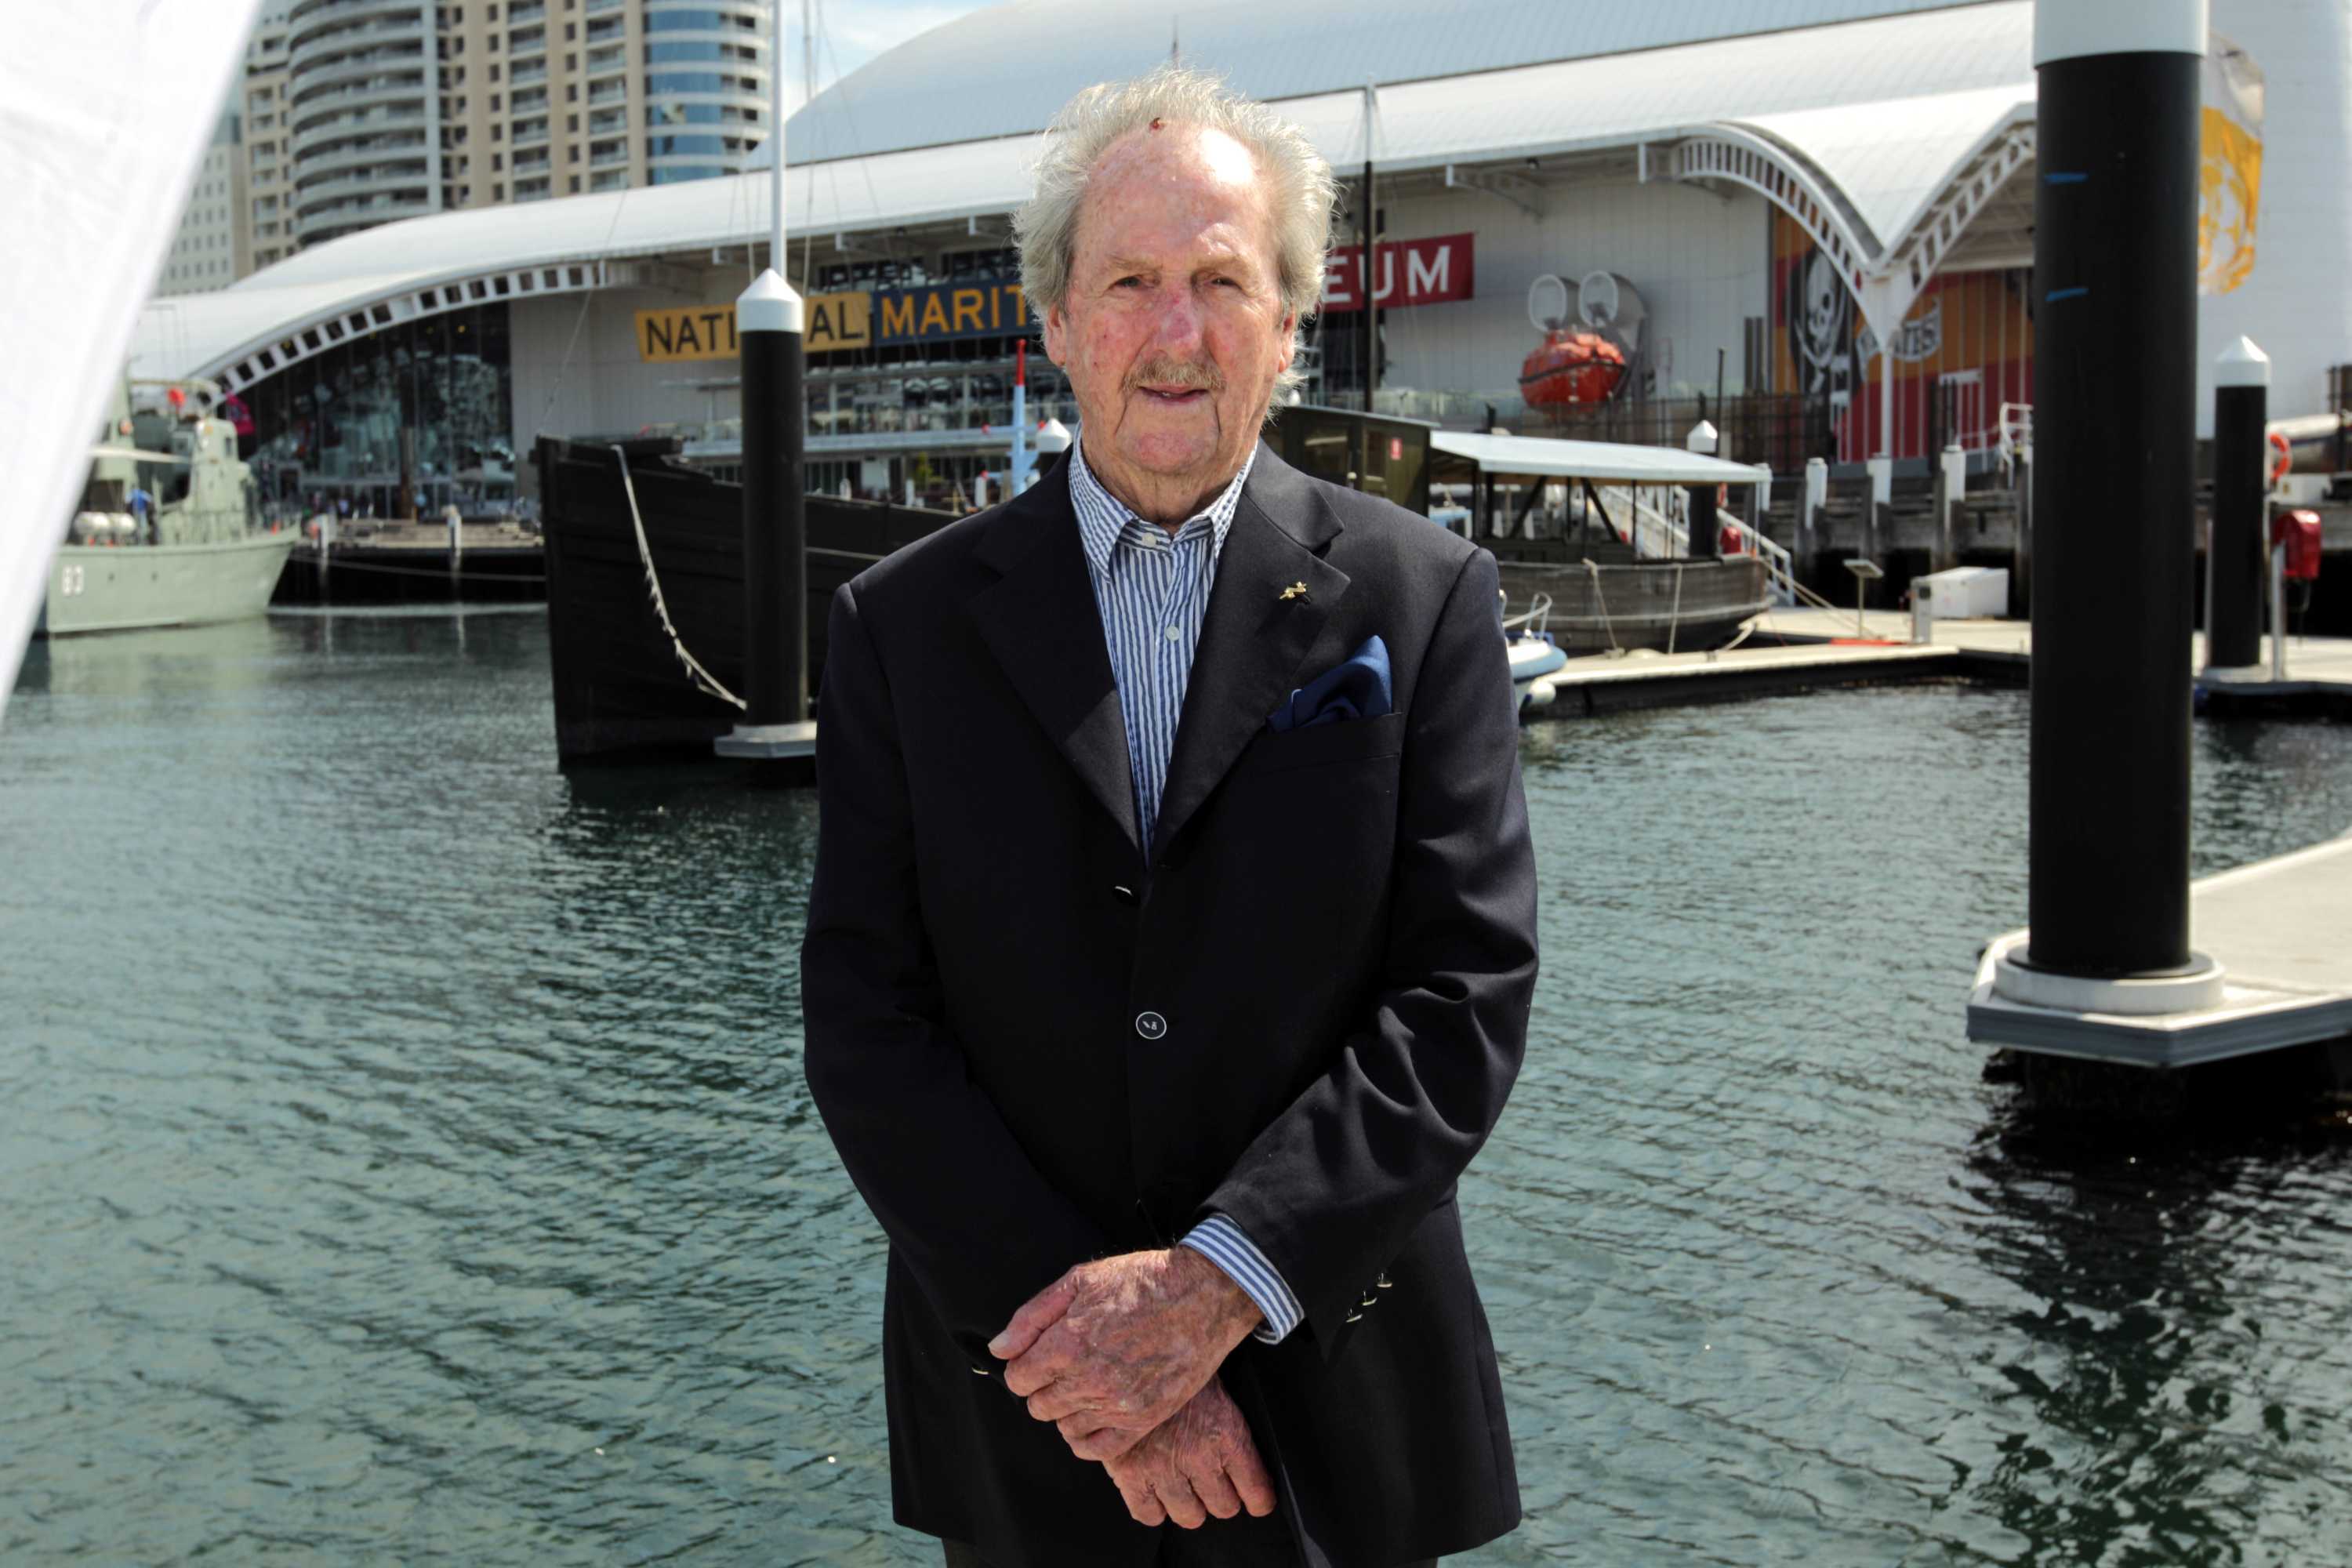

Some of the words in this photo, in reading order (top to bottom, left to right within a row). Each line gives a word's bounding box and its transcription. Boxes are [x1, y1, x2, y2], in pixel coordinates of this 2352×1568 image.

[645, 301, 864, 354] NATIAL
[881, 284, 1027, 339] MARIT
[1320, 245, 1450, 303] EUM
